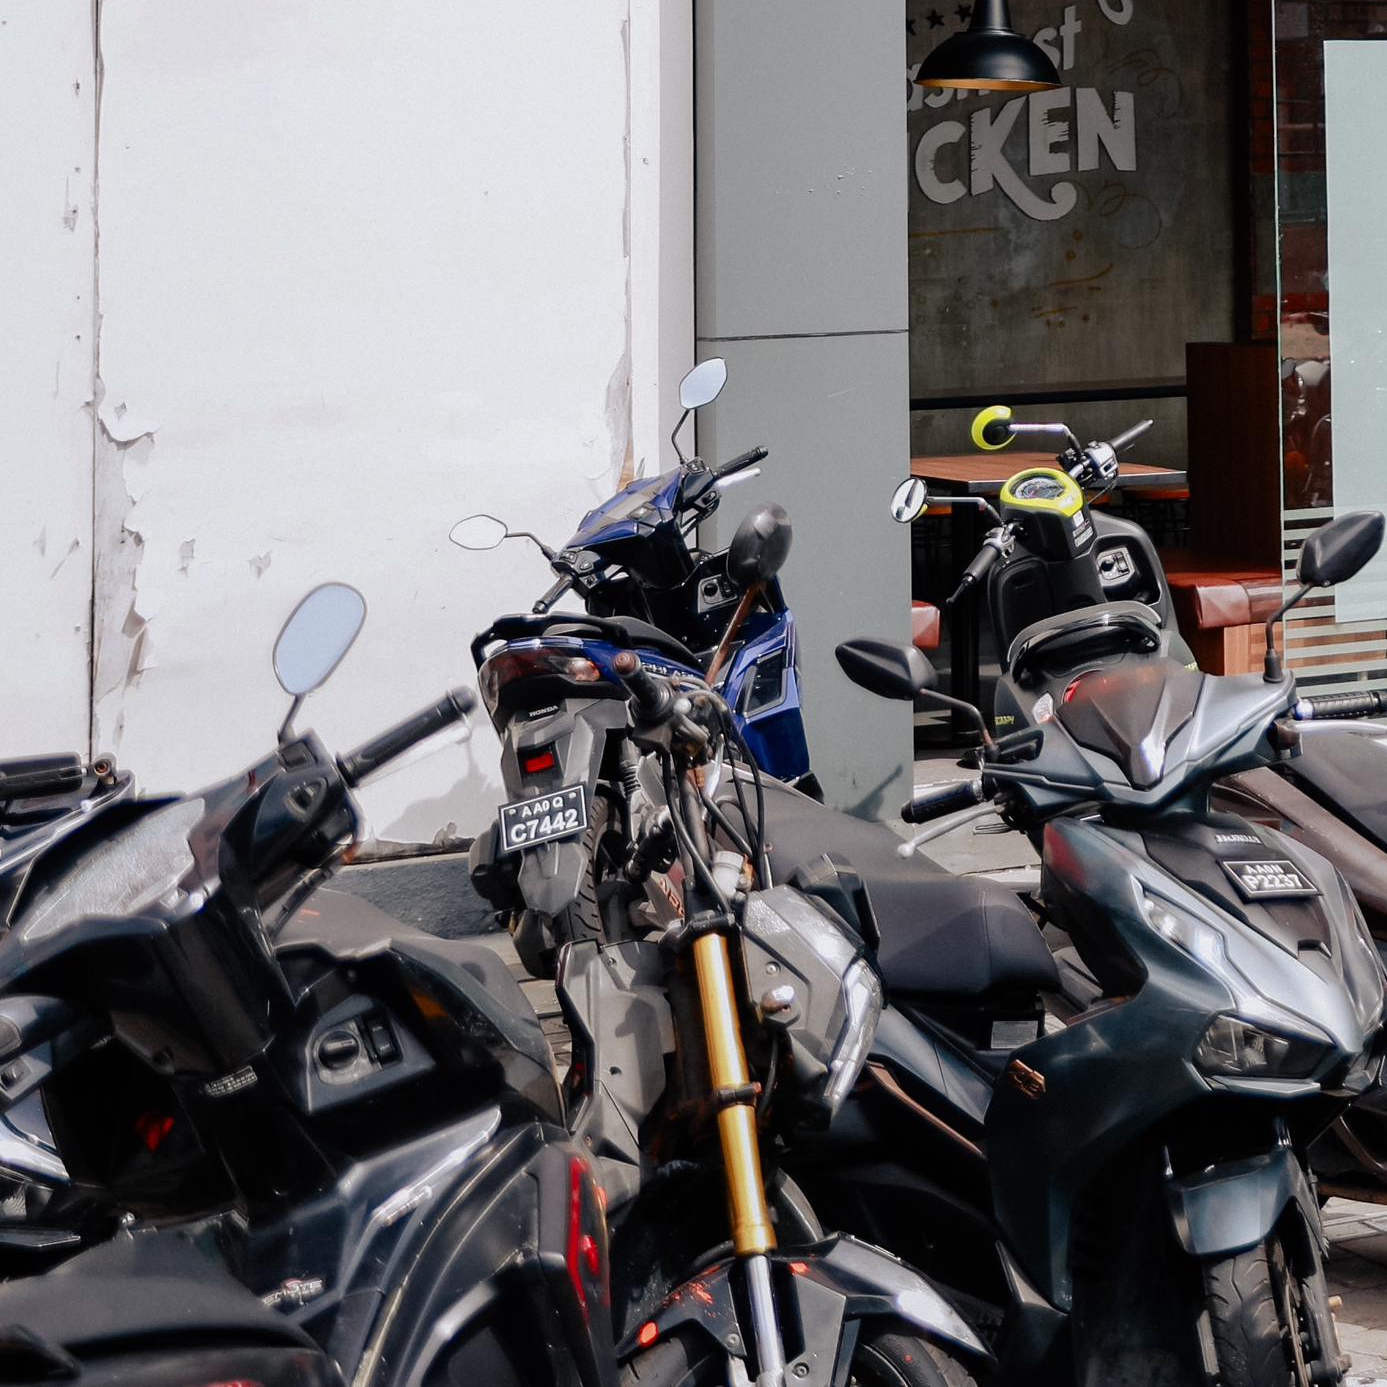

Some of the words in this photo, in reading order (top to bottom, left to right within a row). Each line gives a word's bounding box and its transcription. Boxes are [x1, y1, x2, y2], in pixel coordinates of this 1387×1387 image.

[529, 705, 559, 718] HONDA
[510, 808, 579, 844] C7442
[1241, 873, 1303, 890] P2237
